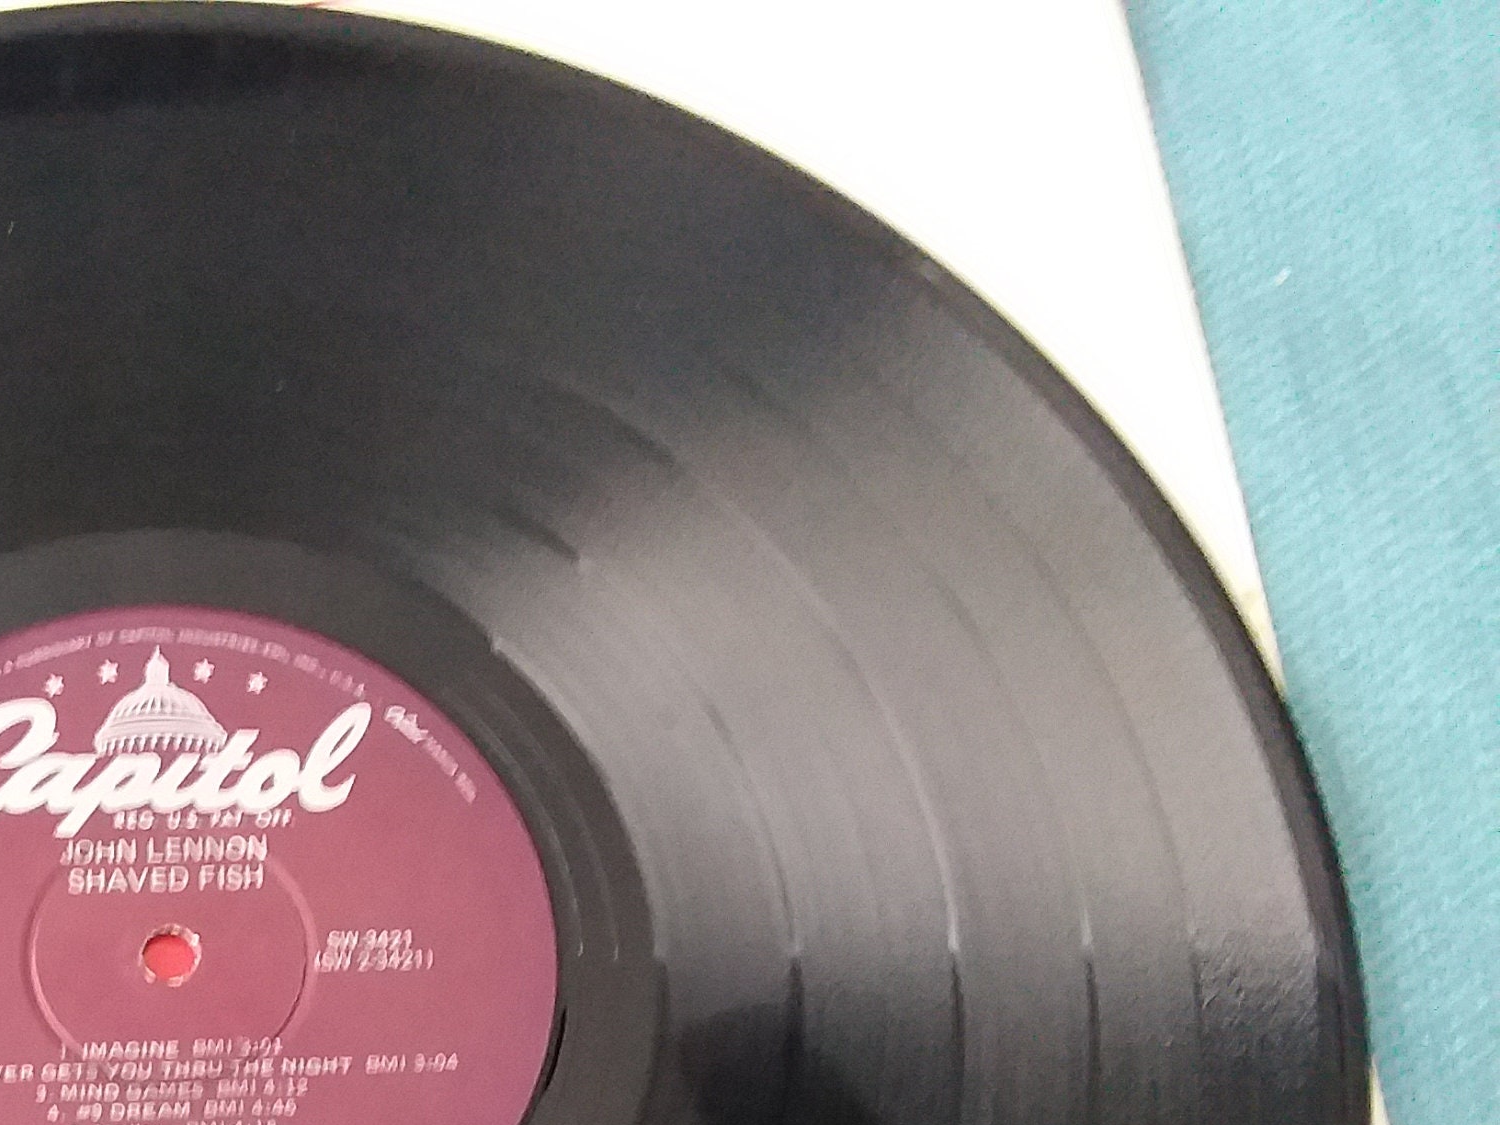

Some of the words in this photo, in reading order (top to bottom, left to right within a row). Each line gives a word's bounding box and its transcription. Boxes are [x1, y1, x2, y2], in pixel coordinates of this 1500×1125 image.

[60, 837, 137, 866] JOHN
[146, 833, 269, 864] LENNON
[68, 865, 190, 895] SHAVED
[198, 863, 265, 893] FISH
[81, 1040, 179, 1061] IMAGINE
[192, 1037, 233, 1057] BMI
[40, 1061, 98, 1083] GETS
[105, 1060, 154, 1081] YOU
[161, 1058, 223, 1079] THRU
[230, 1056, 275, 1078] THE
[280, 1055, 353, 1077] NIGHT
[365, 1053, 407, 1075] BMI
[60, 1082, 120, 1103] MIND
[126, 1079, 204, 1101] GAMES
[216, 1077, 257, 1098] BMI
[109, 1100, 191, 1121] DREAM
[204, 1098, 245, 1119] BMI
